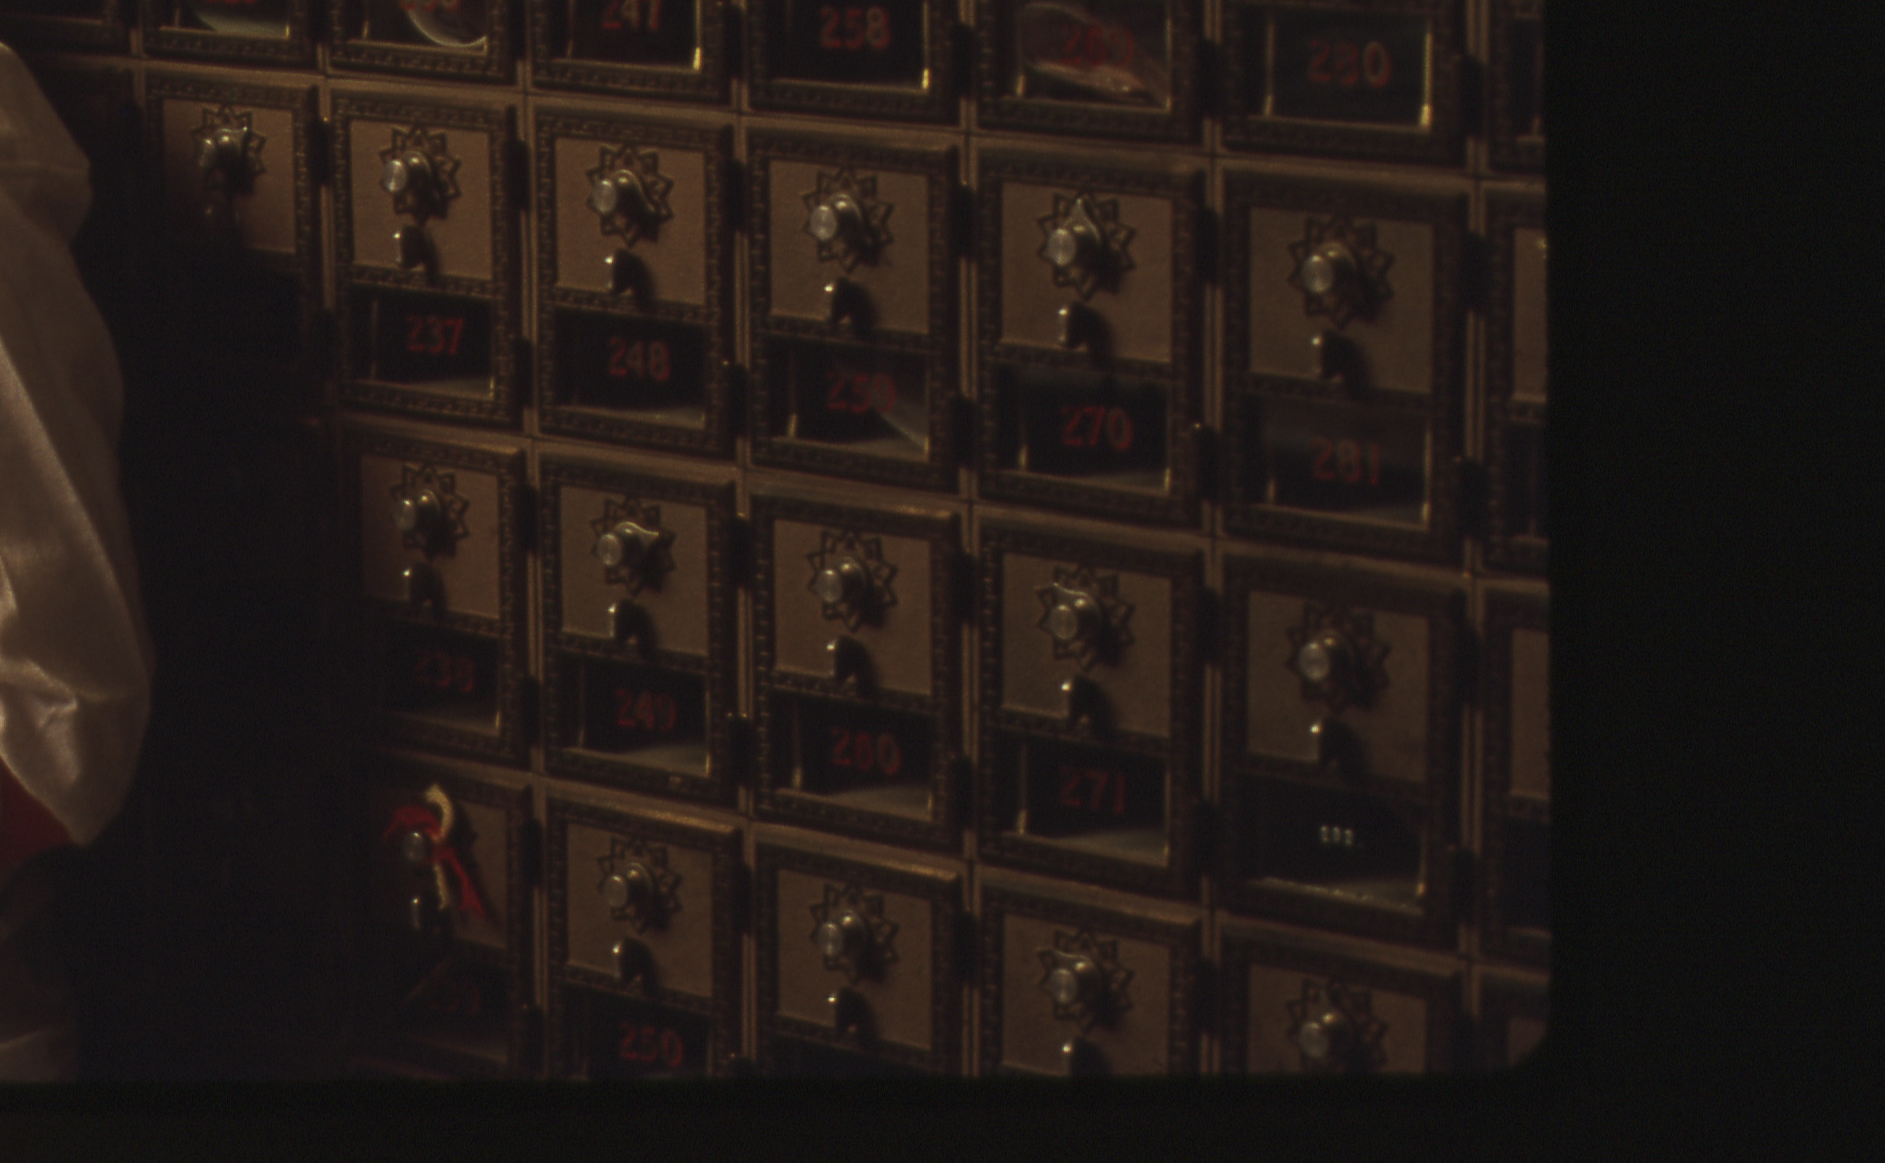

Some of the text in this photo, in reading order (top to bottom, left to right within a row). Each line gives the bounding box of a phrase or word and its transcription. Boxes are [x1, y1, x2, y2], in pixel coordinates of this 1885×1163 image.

[820, 6, 890, 50] 258
[406, 315, 463, 356] 237
[608, 337, 671, 381] 248
[1060, 405, 1132, 451] 270
[1311, 438, 1380, 486] 281
[1059, 767, 1126, 816] 271
[619, 1022, 684, 1068] 250
